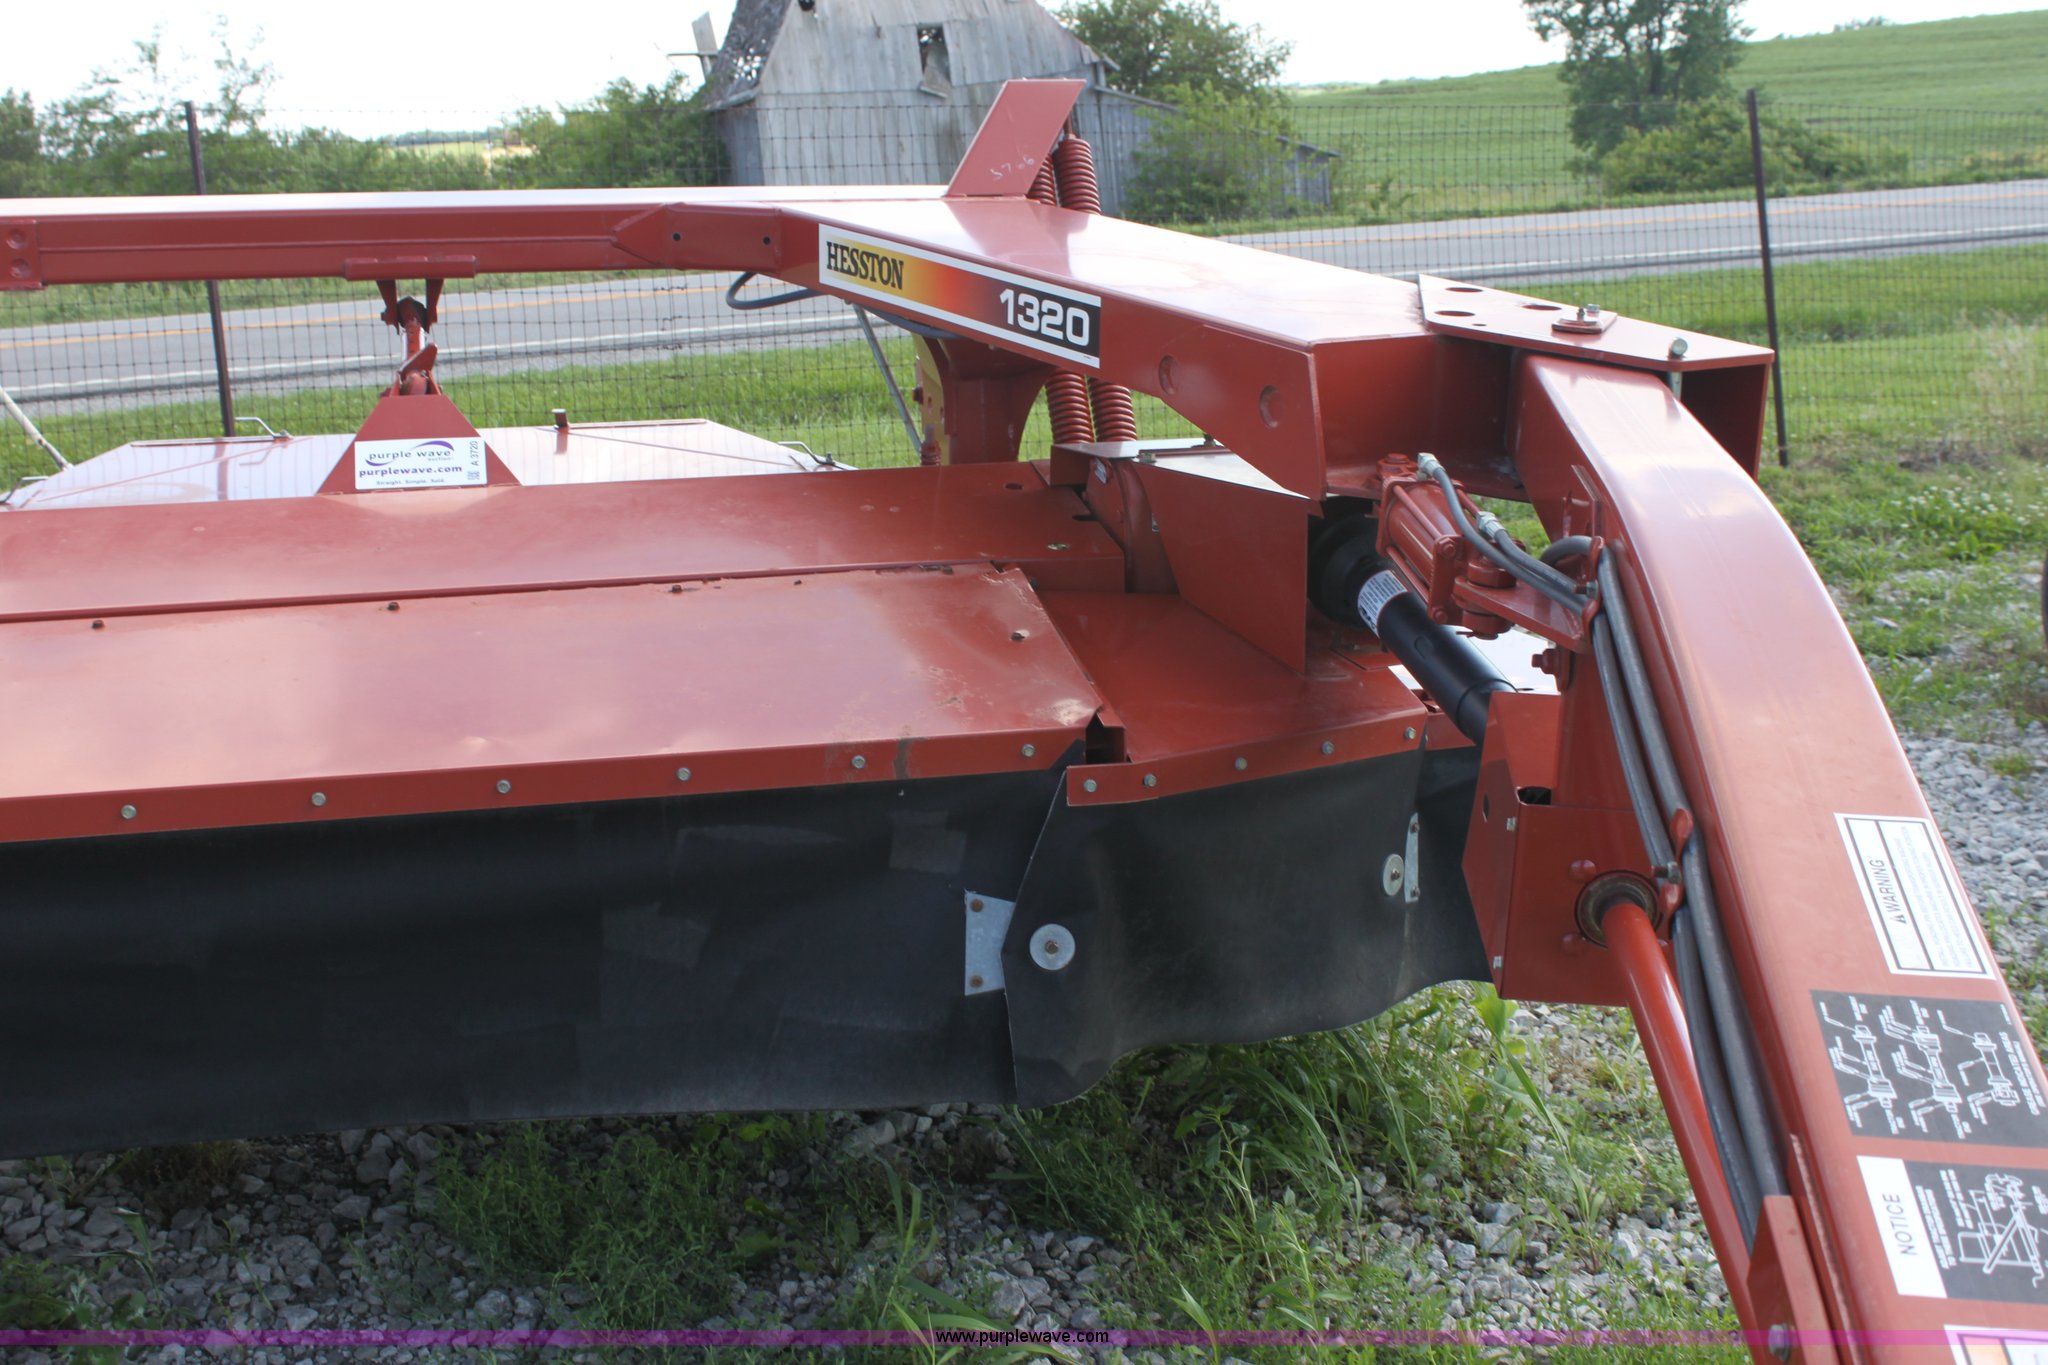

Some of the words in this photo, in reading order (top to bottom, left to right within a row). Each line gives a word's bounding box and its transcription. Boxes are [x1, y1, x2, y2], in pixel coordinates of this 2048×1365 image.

[826, 241, 904, 290] HESSTON
[1000, 288, 1090, 347] 1320
[359, 465, 463, 478] purplewave.com
[369, 450, 412, 461] purple
[416, 450, 451, 458] wave
[470, 440, 479, 458] 3720
[1869, 858, 1897, 913] WARNING
[1882, 1192, 1918, 1256] NOTICE
